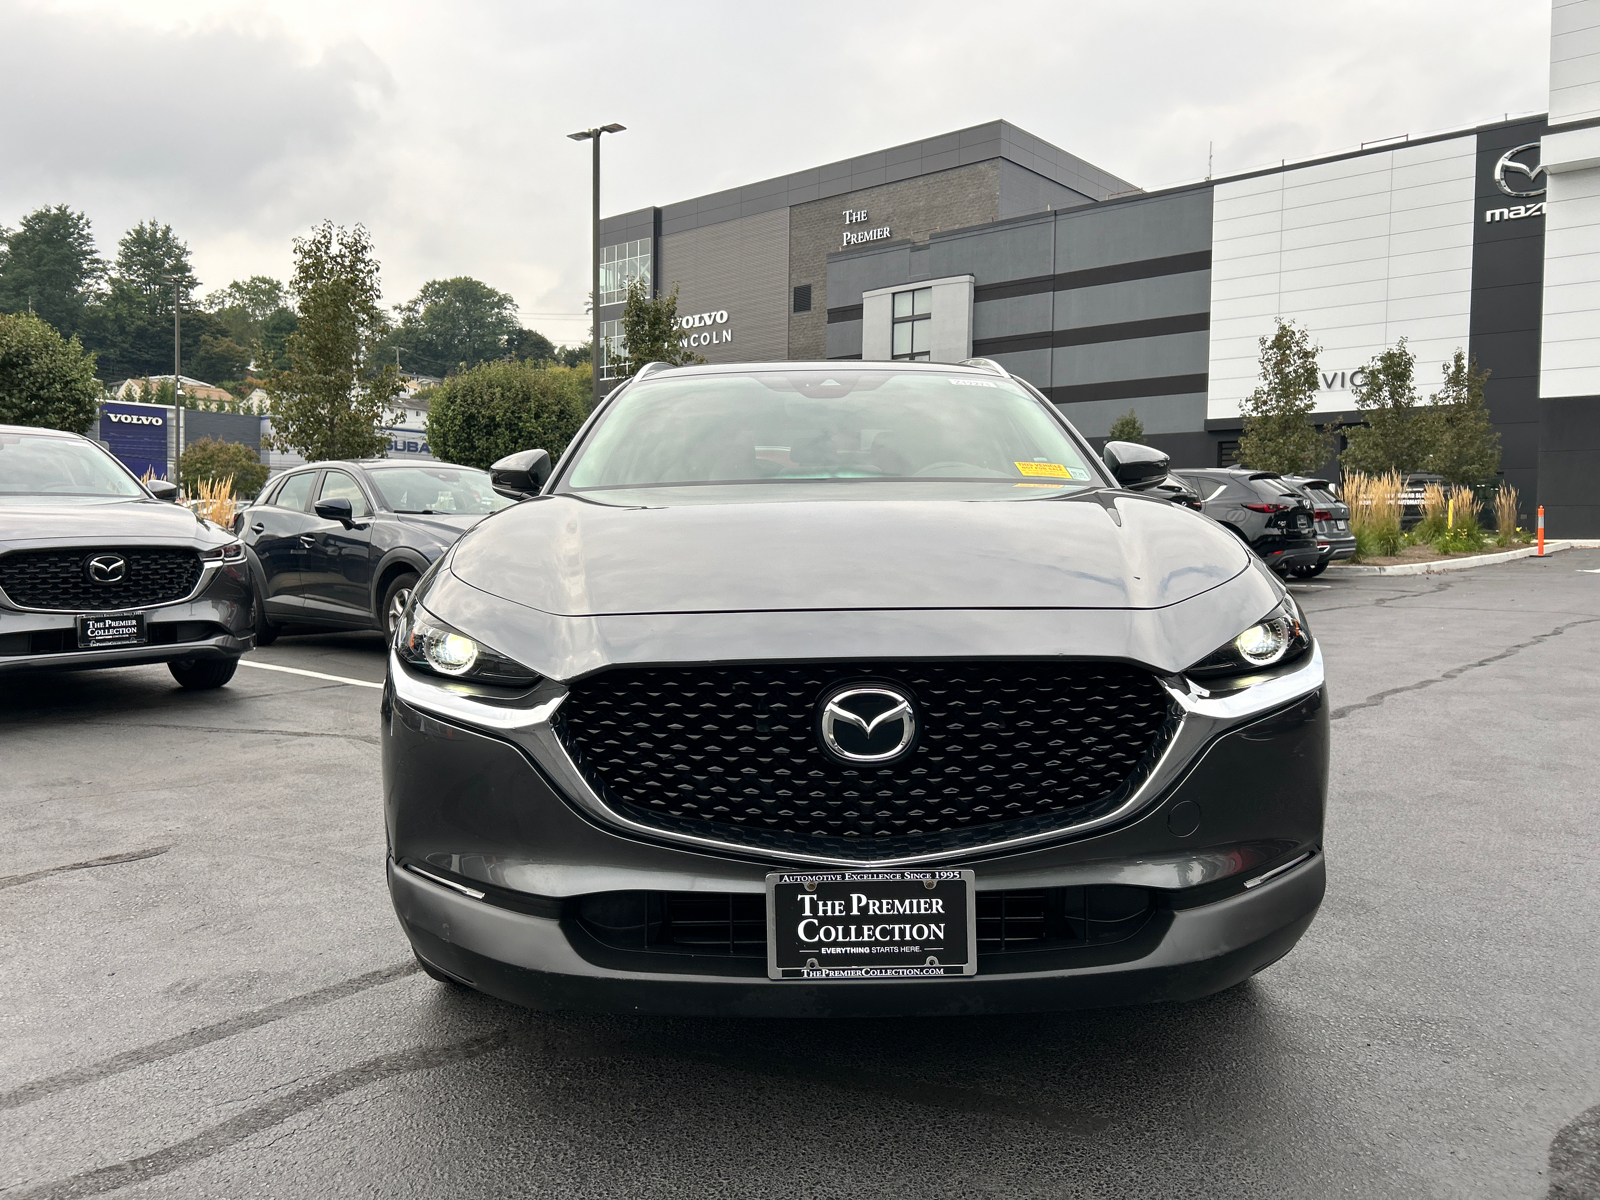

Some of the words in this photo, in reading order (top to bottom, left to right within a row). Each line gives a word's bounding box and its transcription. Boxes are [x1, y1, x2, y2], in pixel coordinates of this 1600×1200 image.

[842, 209, 868, 225] THE
[842, 226, 891, 246] PREMIER
[1321, 370, 1370, 389] VIC
[107, 413, 163, 426] VOLVO
[87, 621, 104, 629] THE
[105, 620, 137, 628] PREMIER
[87, 627, 137, 637] COLLECTION
[781, 874, 843, 883] AUTOMOTIVE
[845, 872, 902, 881] EXCELLENCE
[904, 871, 932, 880] SINCE
[935, 871, 960, 879] 1995
[797, 894, 846, 916] THE
[850, 893, 945, 915] PREMIER
[797, 918, 946, 942] COLLECTION
[801, 968, 944, 977] THEPREMIERCOLLECTION.COM
